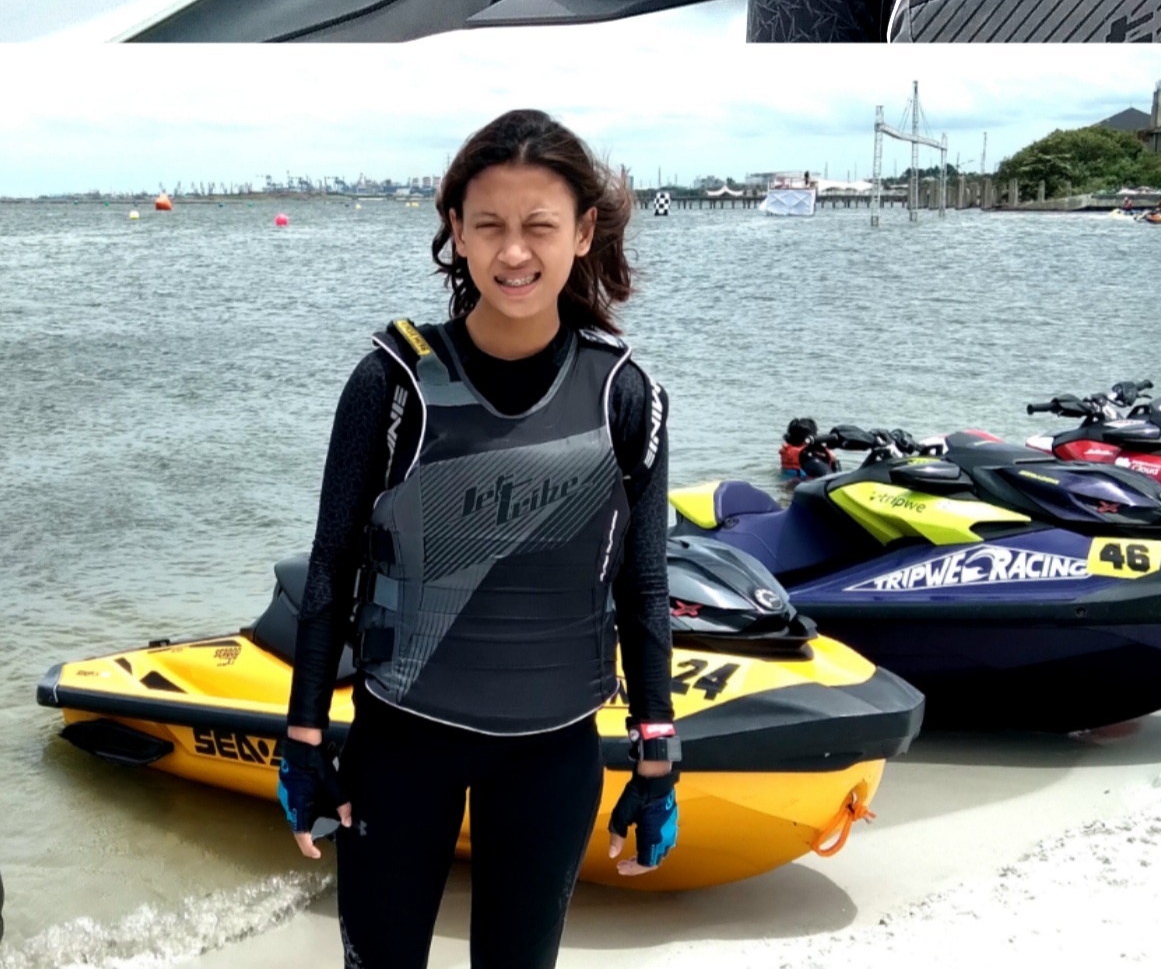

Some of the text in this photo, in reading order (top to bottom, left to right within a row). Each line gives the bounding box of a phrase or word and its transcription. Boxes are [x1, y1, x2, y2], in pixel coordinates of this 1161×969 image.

[878, 493, 926, 513] tripwe
[873, 548, 1088, 591] TRIPWE RACING
[1099, 542, 1151, 572] 46
[671, 658, 741, 701] 24
